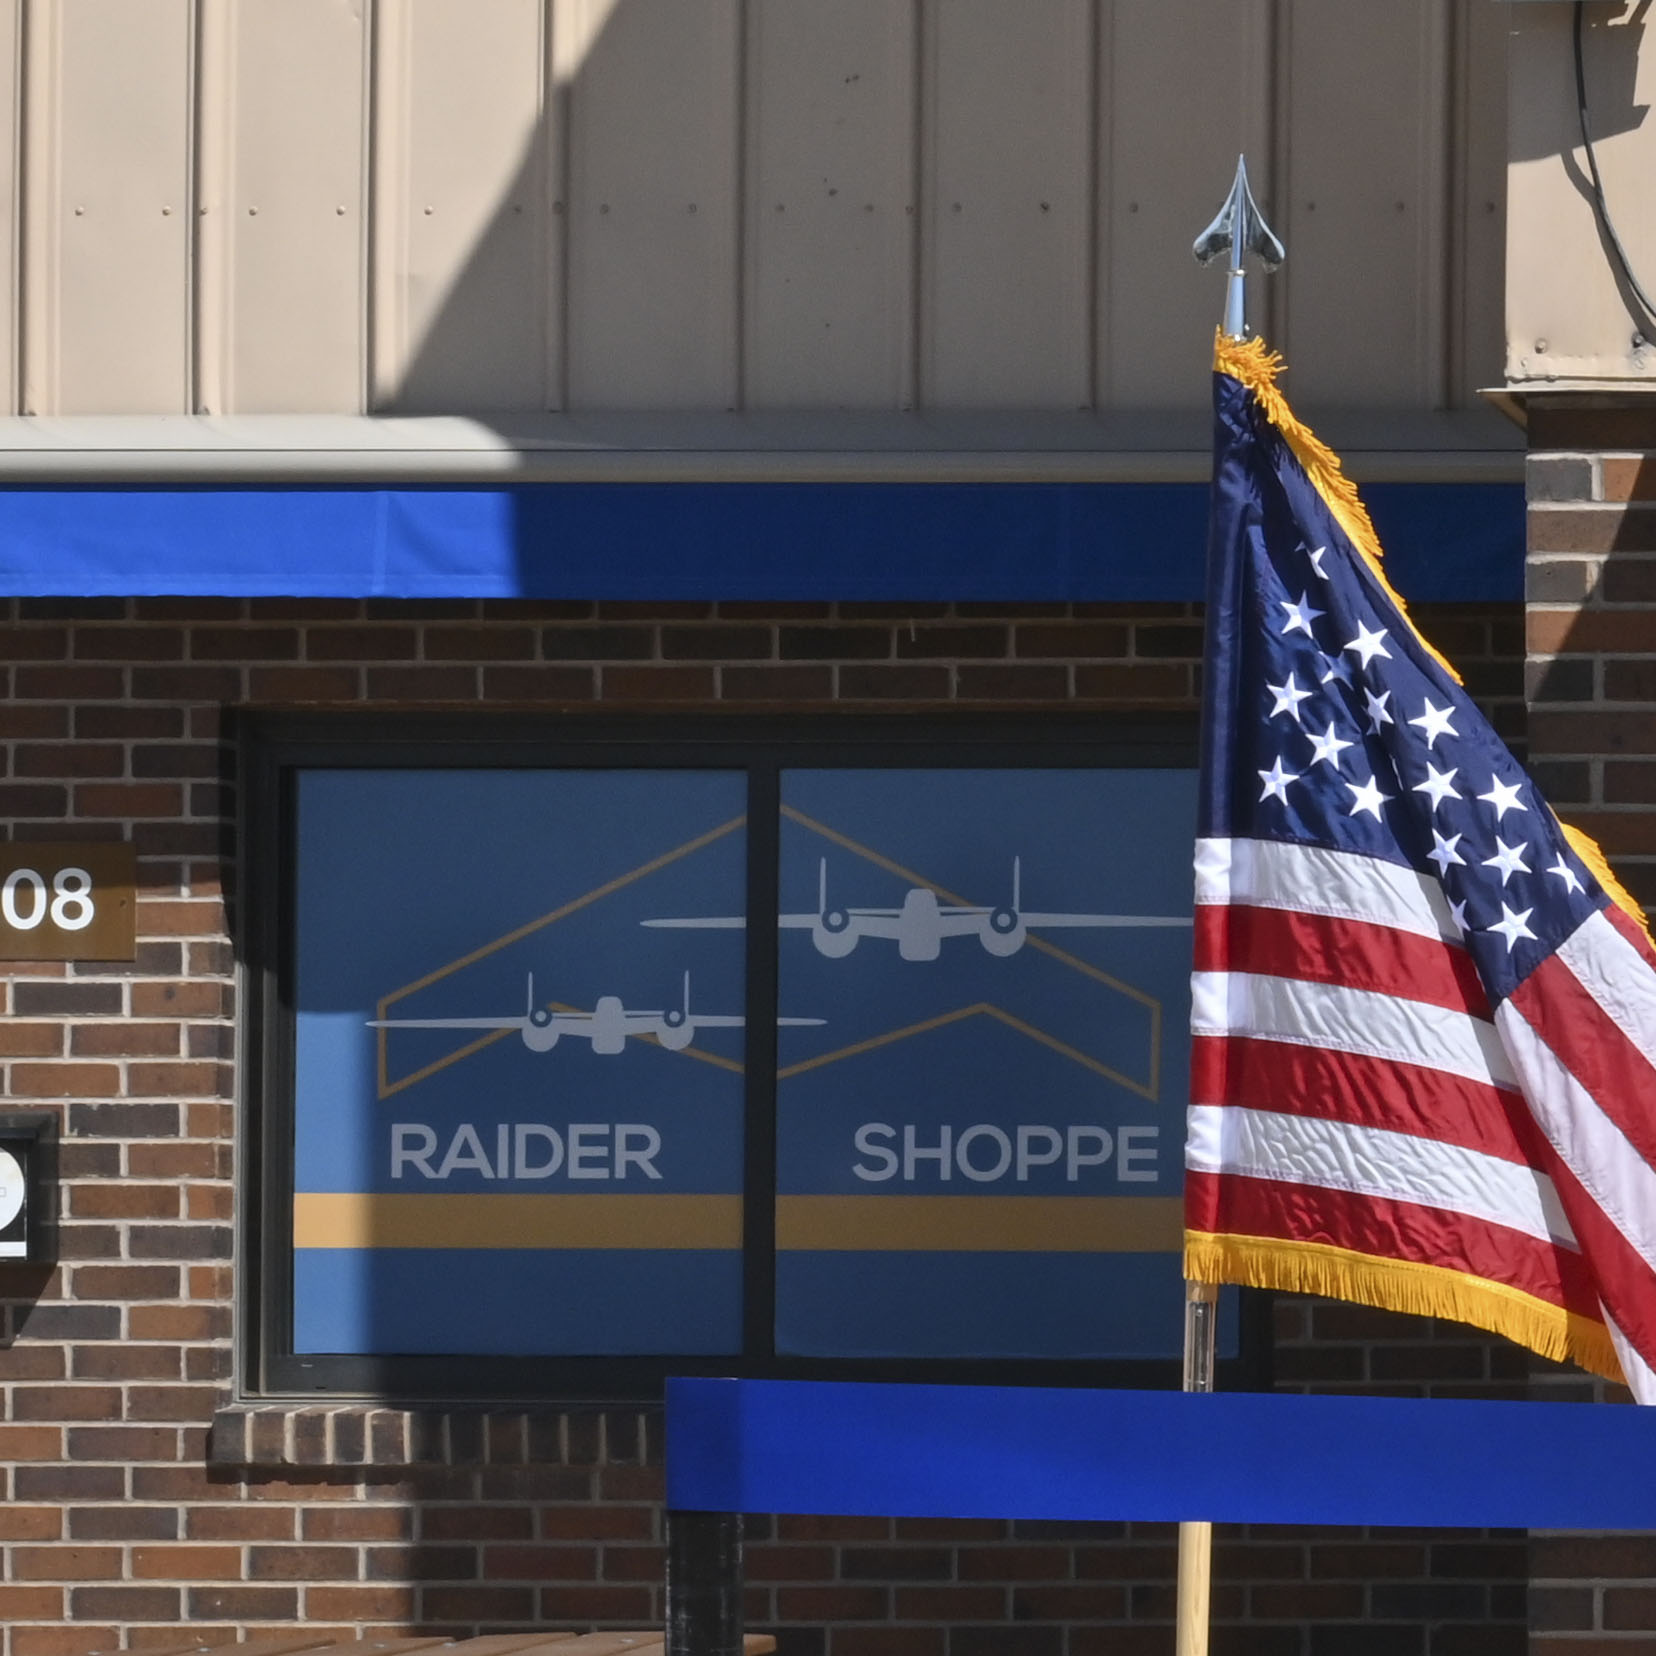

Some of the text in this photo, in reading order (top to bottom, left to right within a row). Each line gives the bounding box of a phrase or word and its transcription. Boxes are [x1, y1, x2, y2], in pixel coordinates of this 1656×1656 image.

[2, 867, 95, 931] 08
[390, 1123, 1159, 1182] RAIDER SHOPPE
